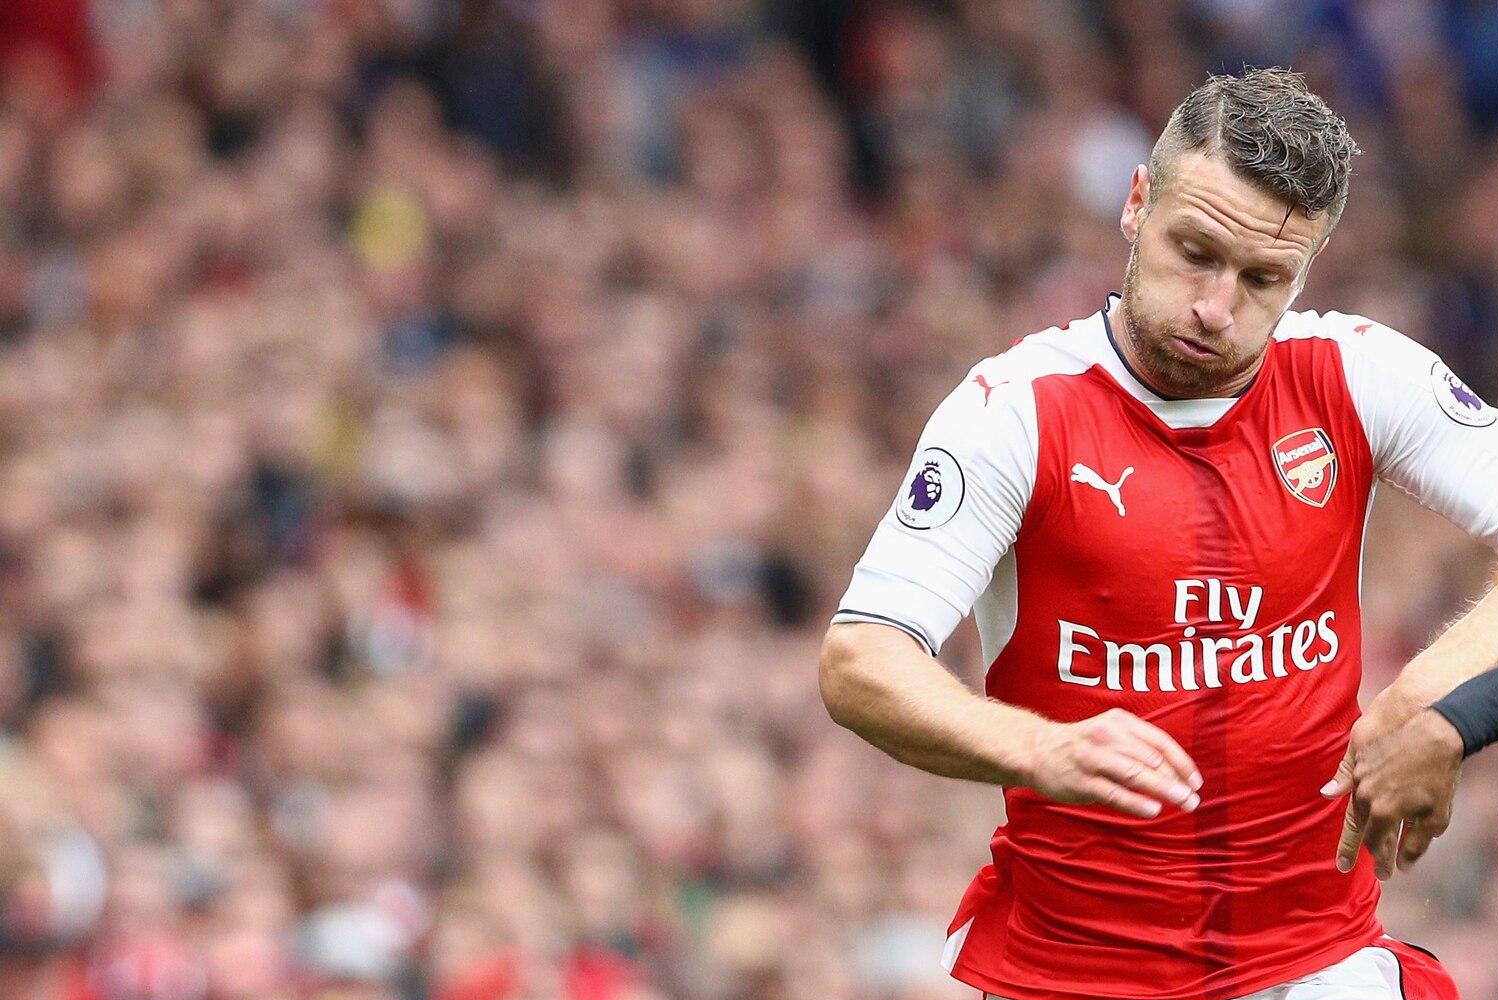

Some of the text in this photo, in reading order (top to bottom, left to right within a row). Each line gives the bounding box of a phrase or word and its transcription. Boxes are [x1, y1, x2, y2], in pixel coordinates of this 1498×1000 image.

[1278, 436, 1325, 466] Arsenal
[1173, 577, 1264, 630] Fly
[1057, 610, 1340, 693] Emirates
